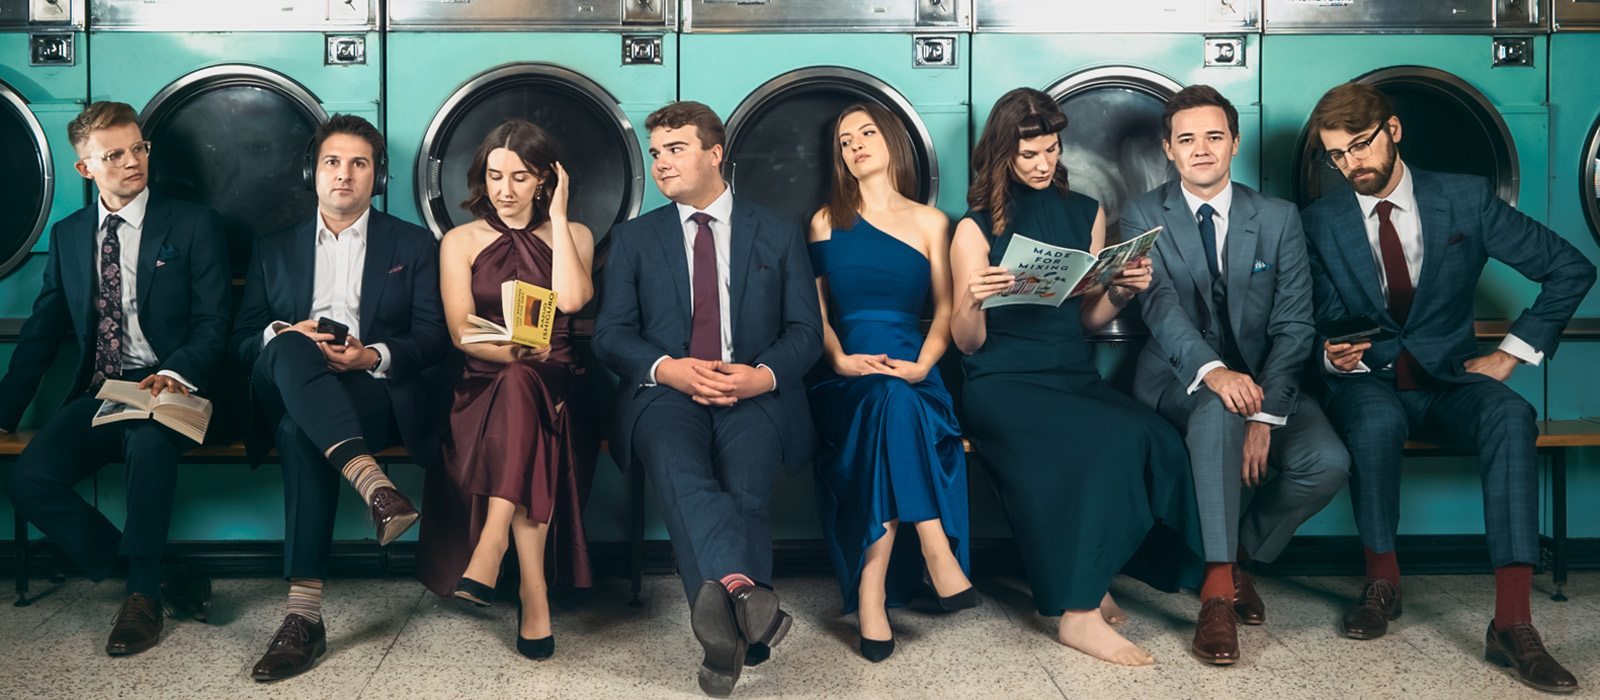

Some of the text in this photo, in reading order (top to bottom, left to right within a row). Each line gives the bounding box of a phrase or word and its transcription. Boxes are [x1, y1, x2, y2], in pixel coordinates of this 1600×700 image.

[1033, 247, 1072, 258] MADE
[1018, 262, 1069, 271] MIXING
[542, 292, 554, 340] ISHIGURO
